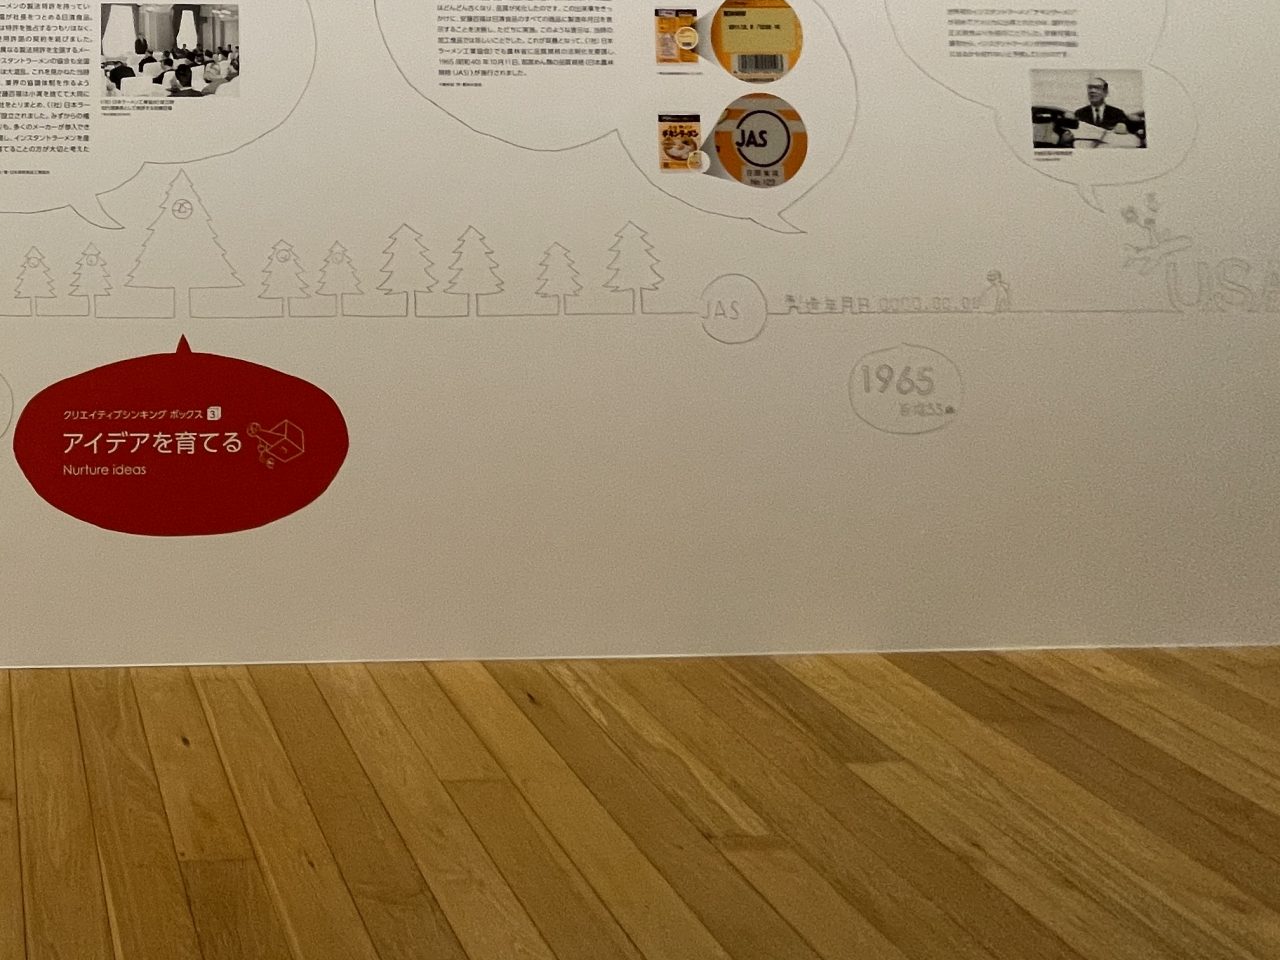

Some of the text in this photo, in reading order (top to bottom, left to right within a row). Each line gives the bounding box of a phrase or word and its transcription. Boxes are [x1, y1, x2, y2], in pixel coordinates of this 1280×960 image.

[735, 129, 768, 148] JAS
[701, 300, 740, 320] JAS
[861, 364, 934, 396] 1965
[64, 410, 167, 420] クリエイティブシンキング
[169, 410, 203, 419] ボックス
[63, 431, 241, 454] アイデアを育てる
[63, 465, 146, 475] Nurture ideas
